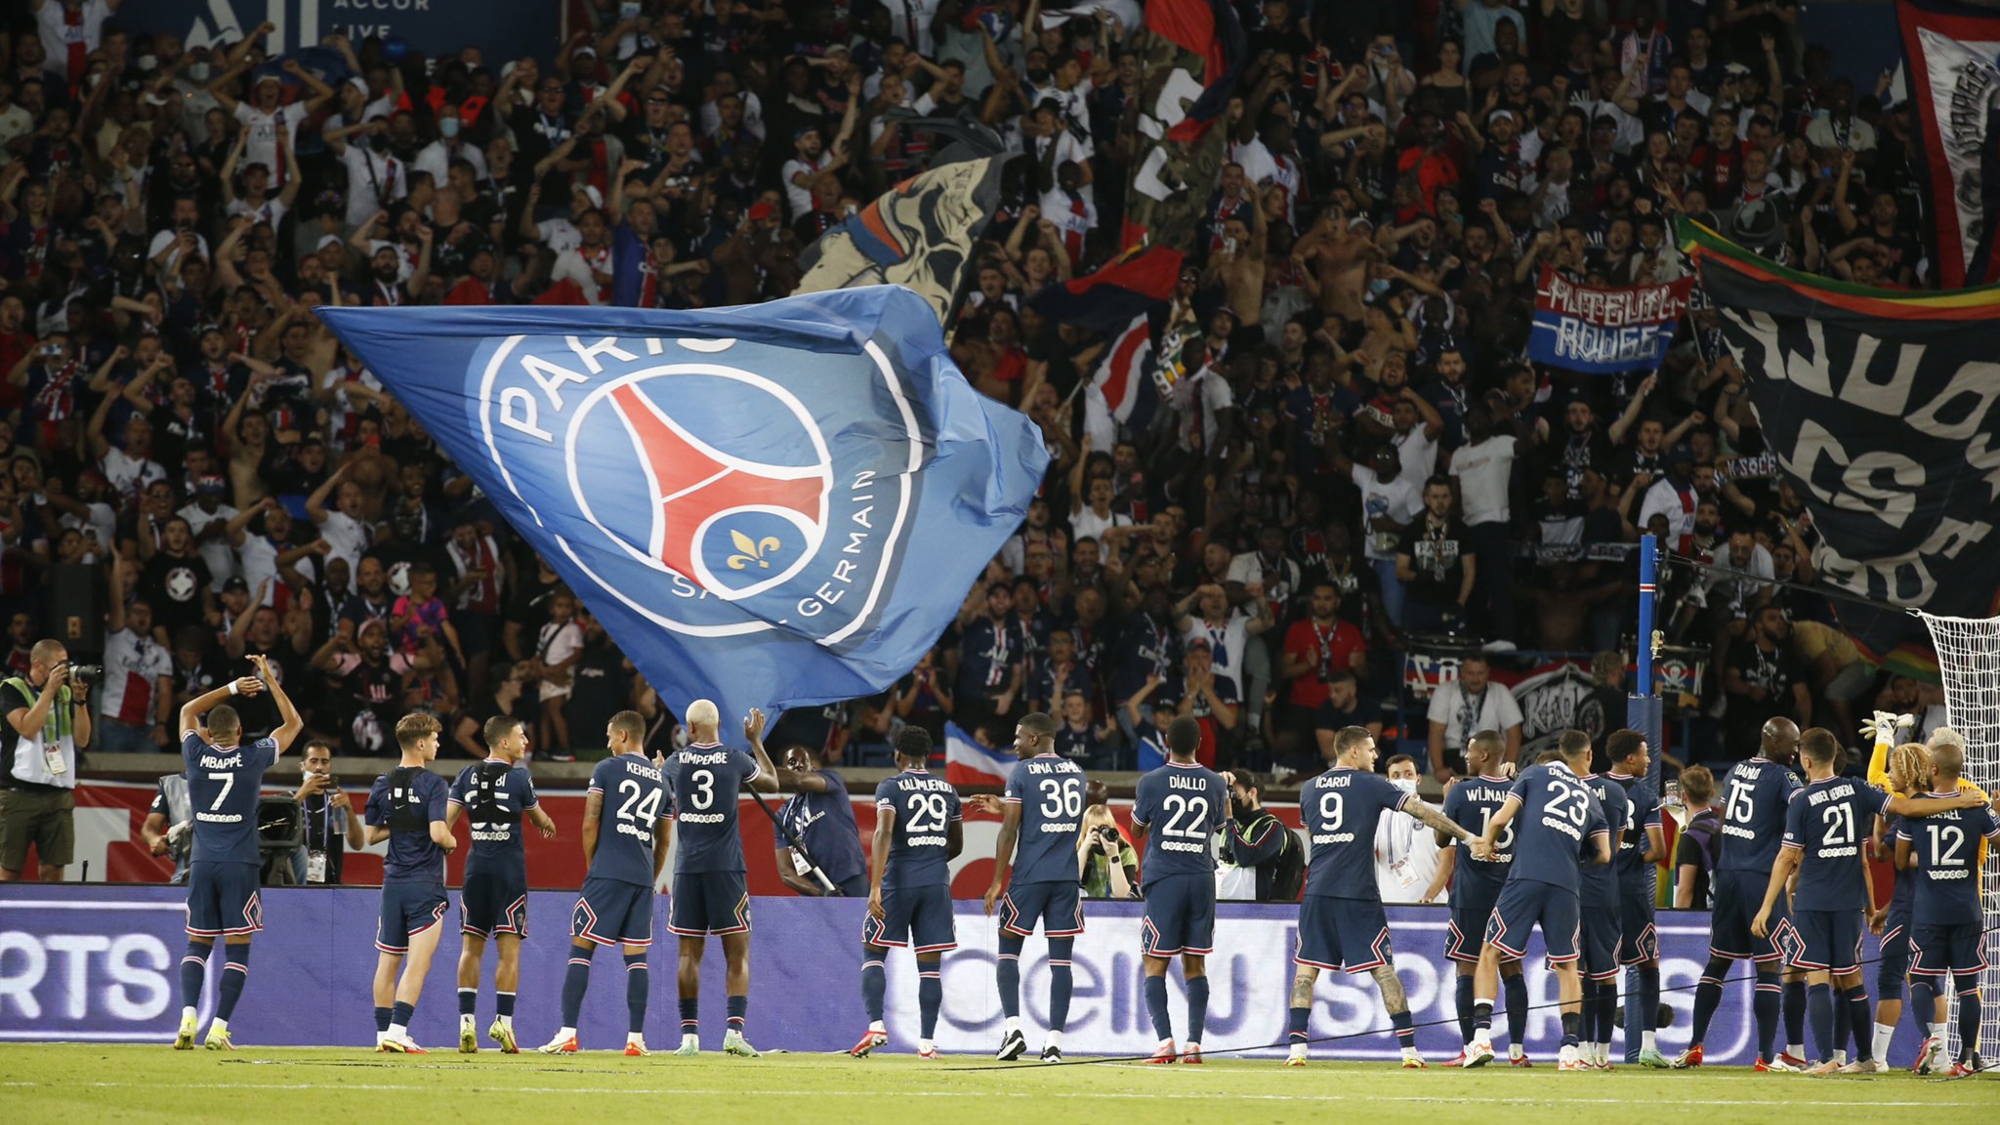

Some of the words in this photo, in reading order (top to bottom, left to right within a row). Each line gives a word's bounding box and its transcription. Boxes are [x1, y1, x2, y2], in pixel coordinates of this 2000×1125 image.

[797, 470, 877, 617] GERMAIN
[626, 761, 663, 783] KEHRER
[678, 751, 728, 766] KIMPEMBE
[208, 772, 235, 811] 7
[691, 769, 715, 810] 3
[1039, 778, 1082, 819] 36
[1169, 774, 1207, 792] DIALLO
[1315, 774, 1352, 789] ICARDI
[1725, 778, 1755, 824] 15
[616, 779, 663, 828] 24
[906, 793, 948, 832] 29
[1161, 794, 1209, 840] 22
[1319, 791, 1344, 832] 9
[1543, 781, 1590, 827] 23
[1822, 801, 1855, 846] 21
[1926, 825, 1965, 866] 12
